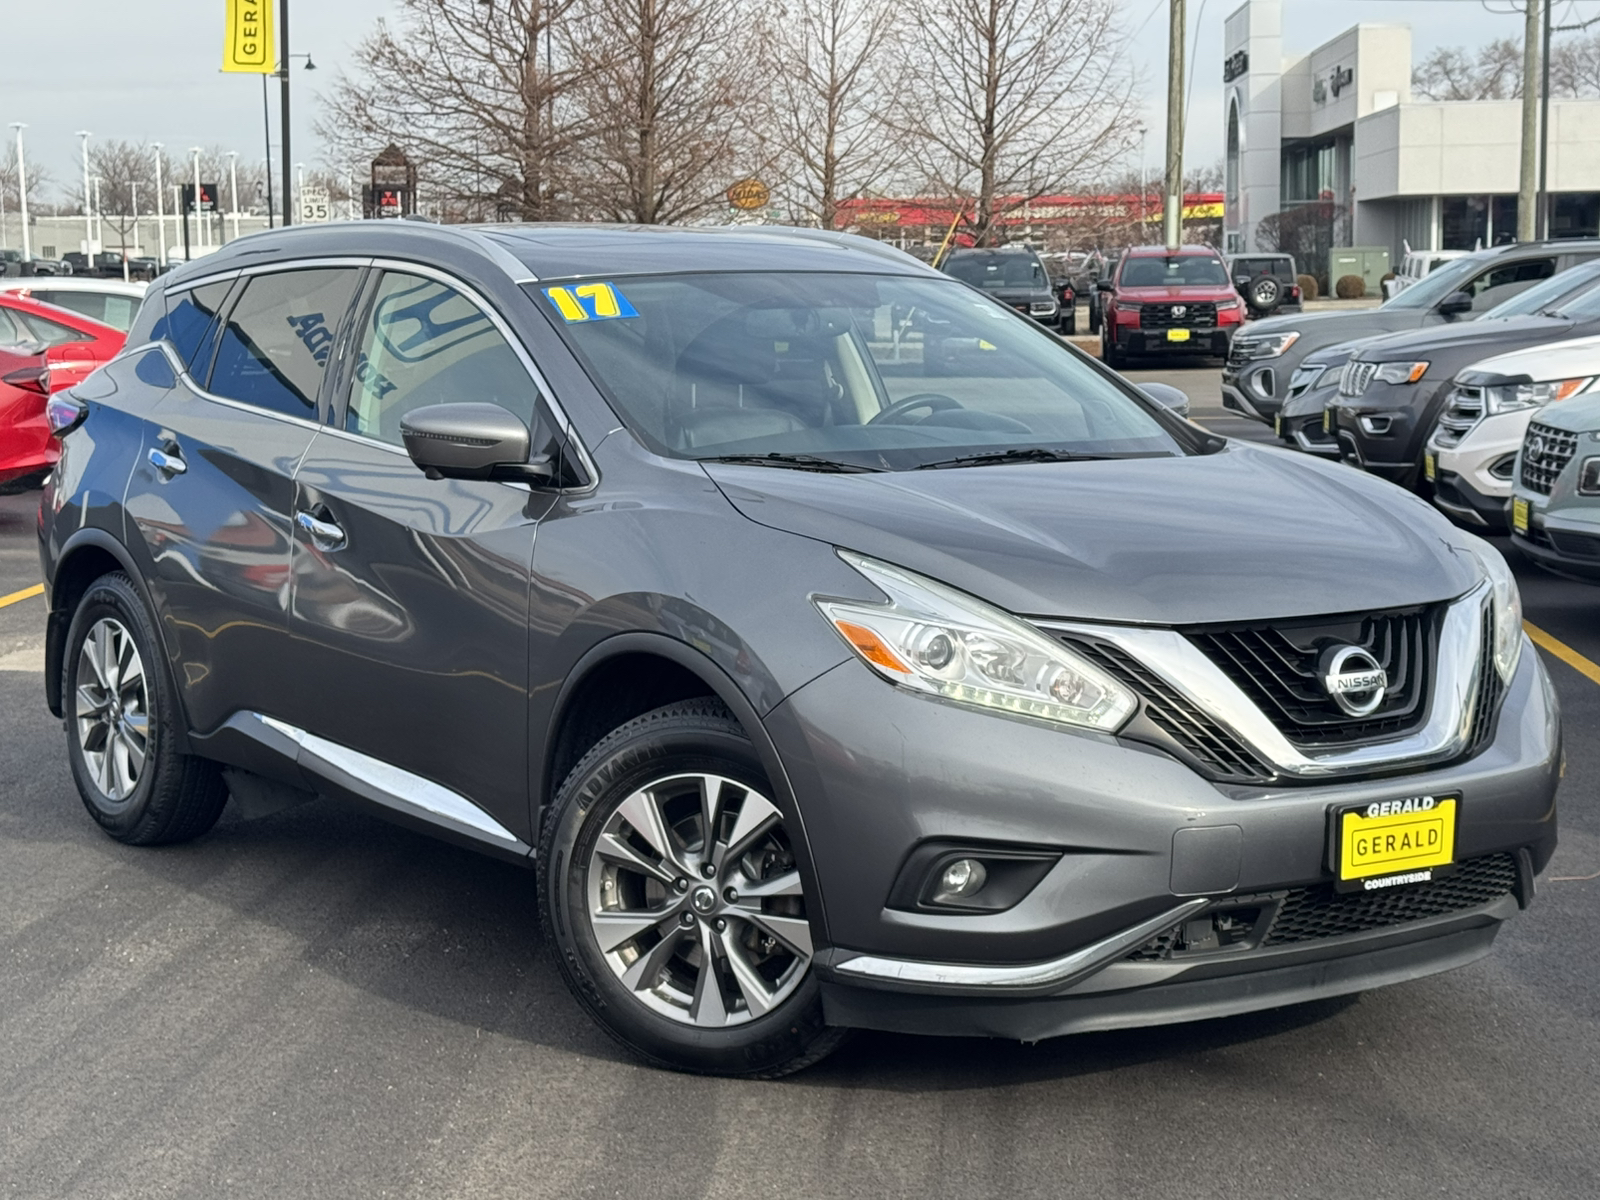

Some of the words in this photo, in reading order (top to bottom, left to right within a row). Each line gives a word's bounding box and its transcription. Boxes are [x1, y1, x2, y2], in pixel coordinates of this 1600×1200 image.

[303, 204, 327, 219] 35
[548, 283, 621, 321] 17
[1337, 672, 1385, 689] NISSAN
[1366, 796, 1435, 818] GERALD
[1356, 828, 1438, 857] GERALD
[1364, 870, 1432, 890] COUNTRYSIDE
